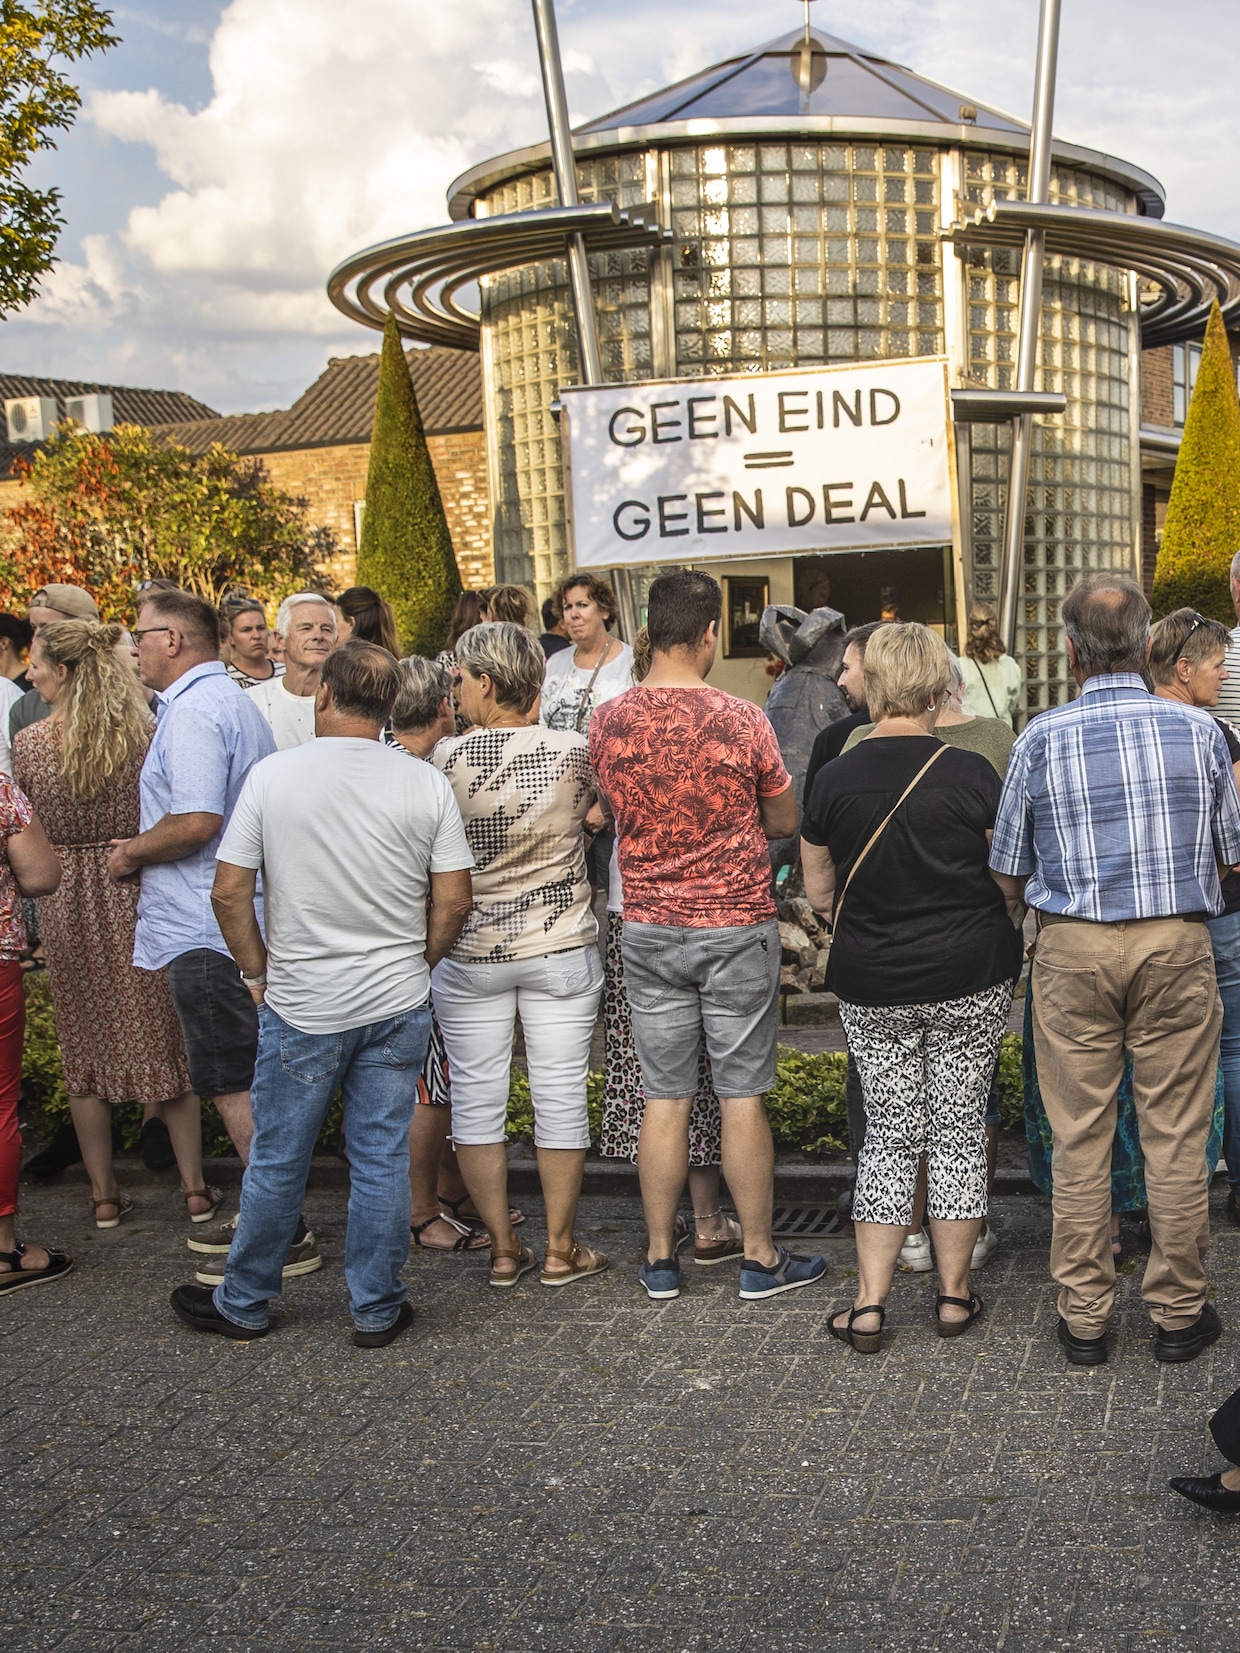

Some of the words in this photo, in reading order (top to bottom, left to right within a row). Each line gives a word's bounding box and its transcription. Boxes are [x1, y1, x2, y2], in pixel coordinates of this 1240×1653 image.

[608, 393, 757, 448] GEEN
[778, 388, 901, 434] EIND
[613, 488, 765, 541] GEEN
[786, 478, 926, 528] DEAL
